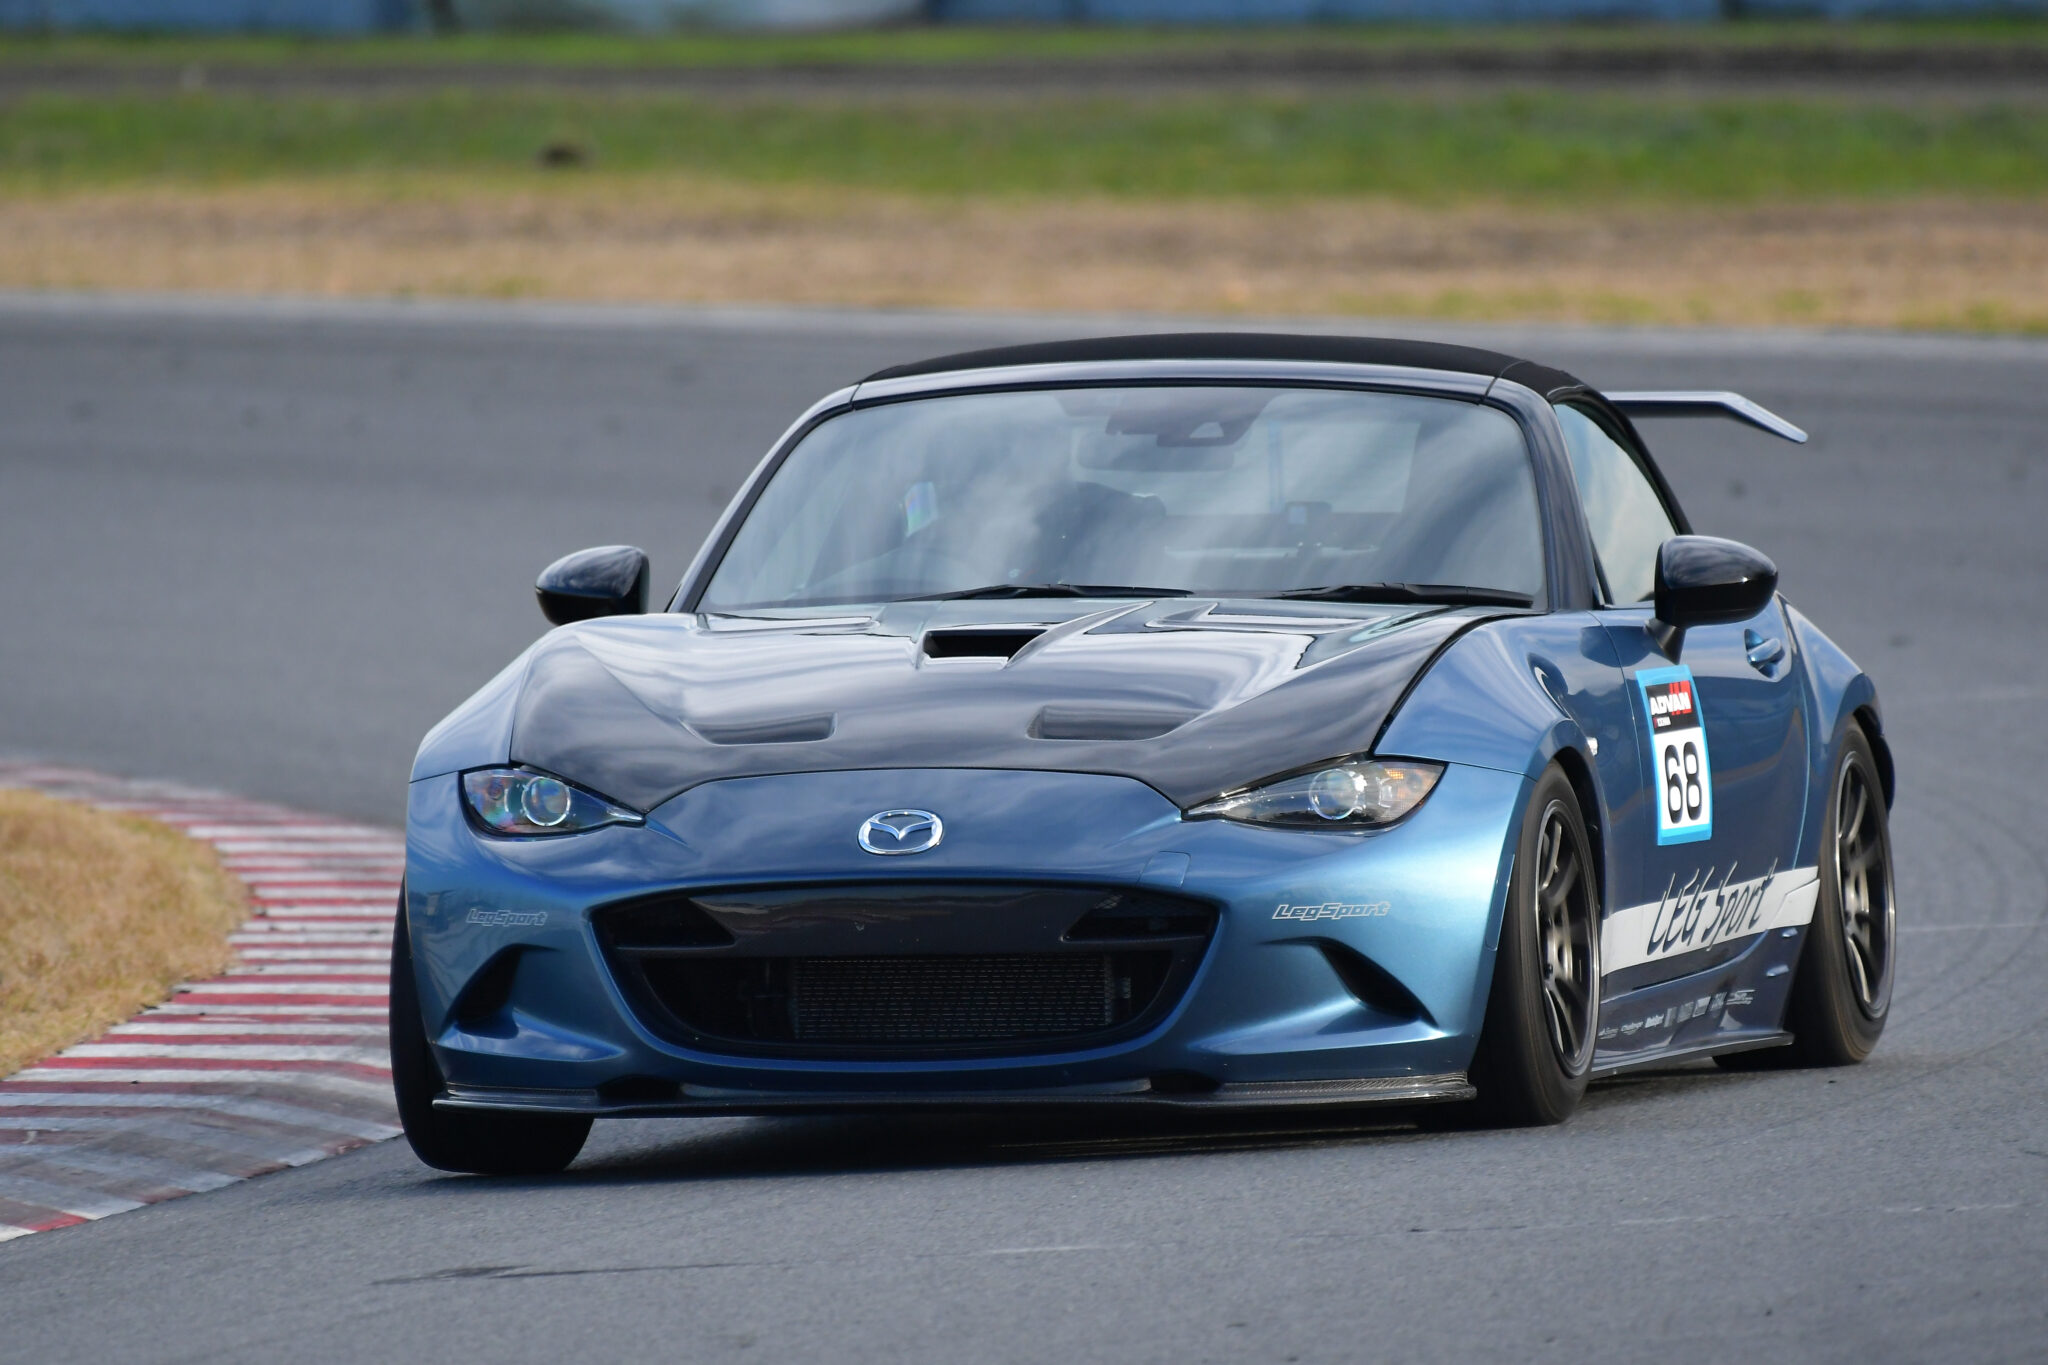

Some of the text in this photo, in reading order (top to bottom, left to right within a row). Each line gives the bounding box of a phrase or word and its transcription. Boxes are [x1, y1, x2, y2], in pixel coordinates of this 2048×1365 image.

[1650, 692, 1691, 715] ADVAN
[1665, 741, 1702, 824] 68
[1272, 902, 1391, 921] LegSport
